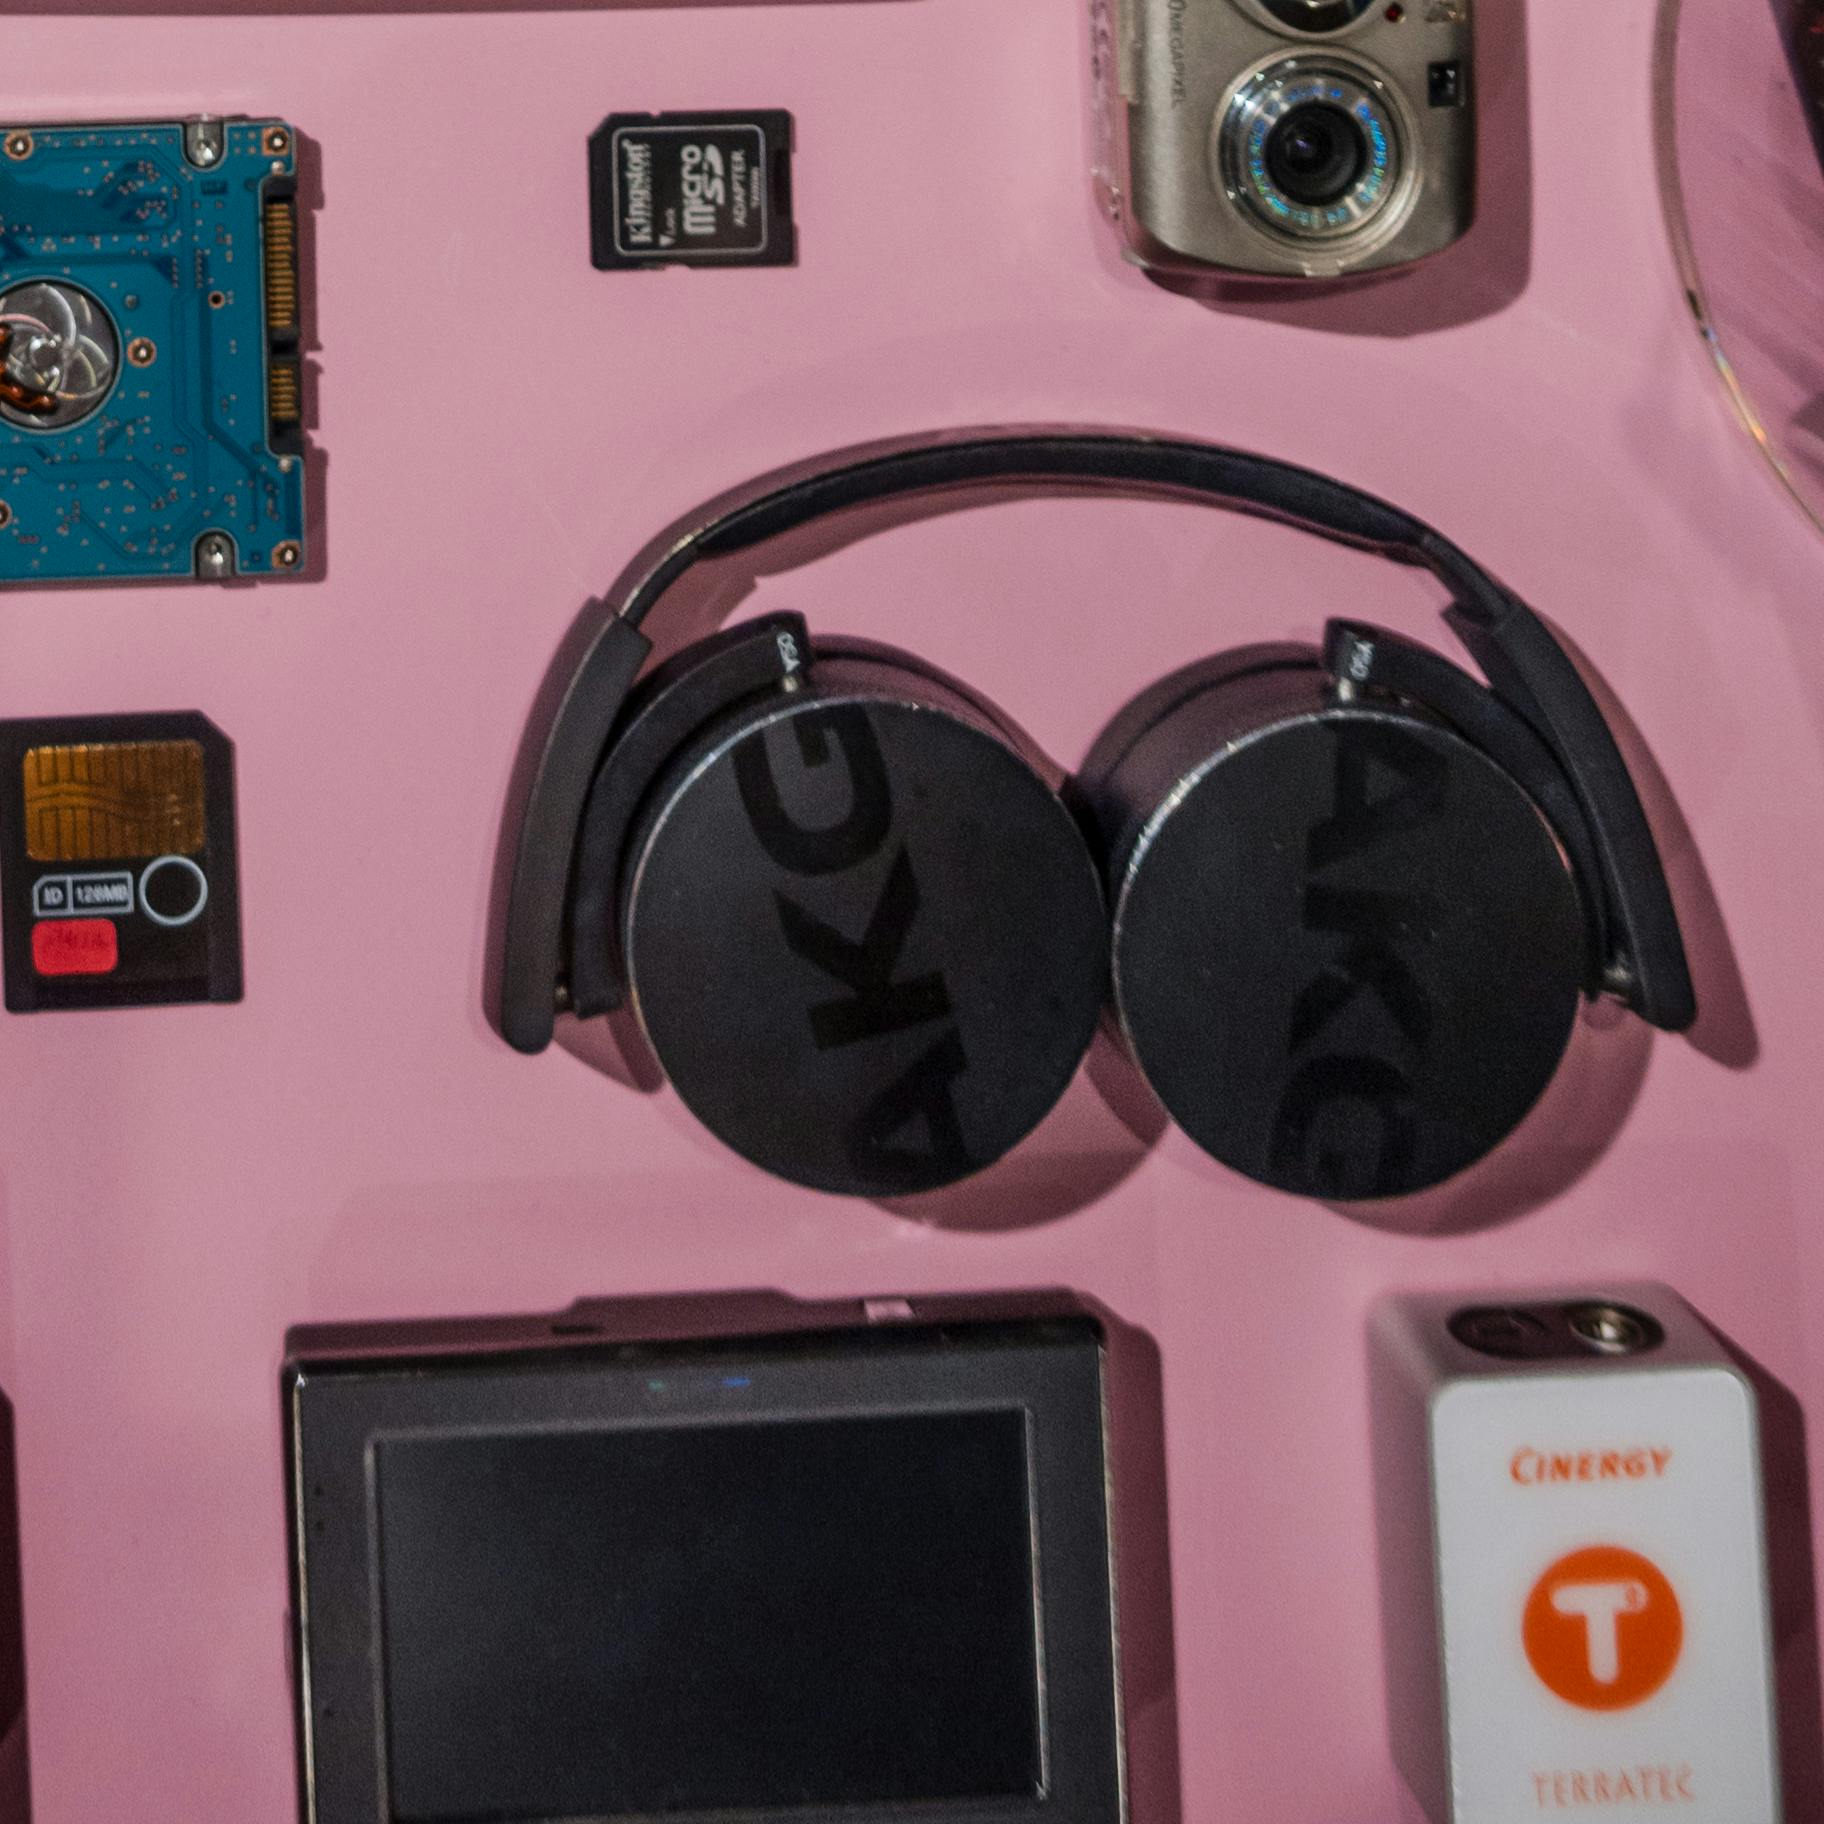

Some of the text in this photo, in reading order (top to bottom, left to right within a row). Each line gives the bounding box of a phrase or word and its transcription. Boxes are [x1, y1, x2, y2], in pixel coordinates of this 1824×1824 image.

[622, 138, 653, 245] Kingston
[732, 704, 970, 1190] AKG
[1509, 1445, 1672, 1486] CINERGY
[1532, 1762, 1696, 1809] TERRATEC
